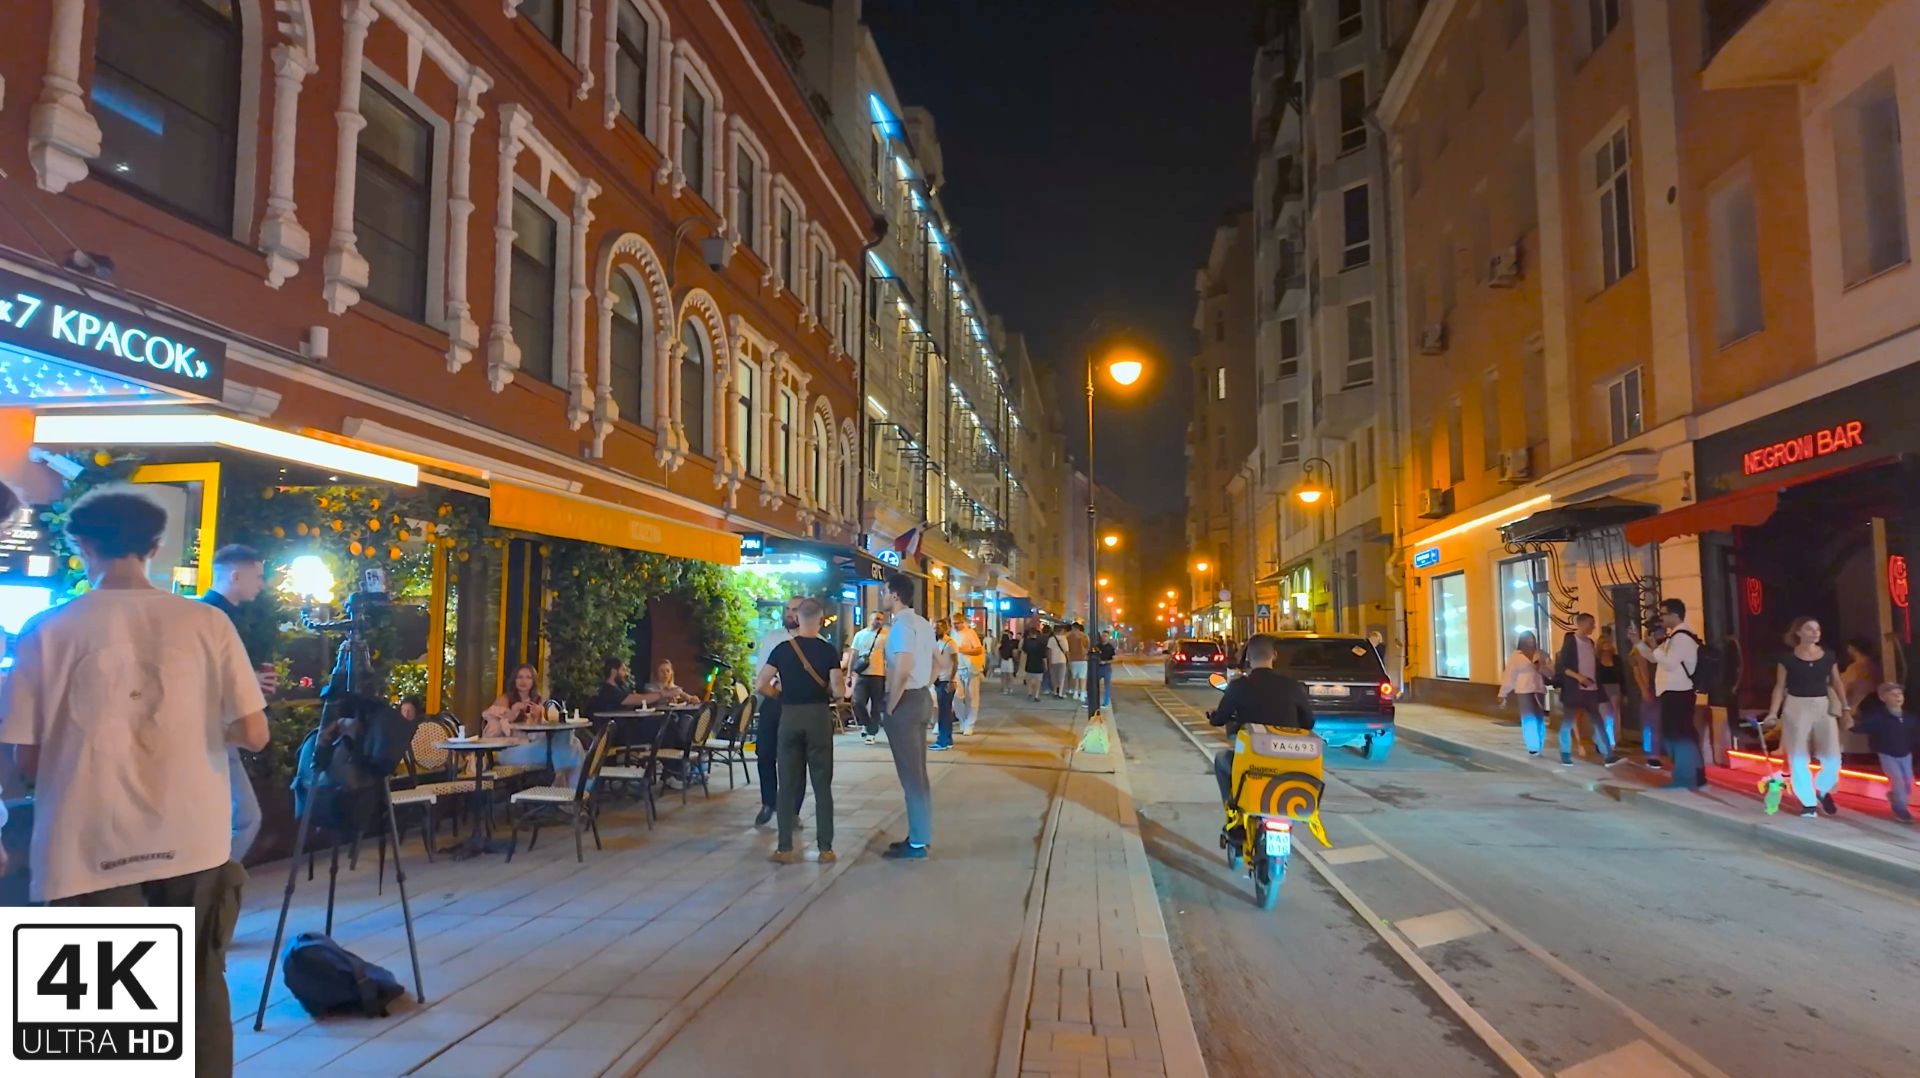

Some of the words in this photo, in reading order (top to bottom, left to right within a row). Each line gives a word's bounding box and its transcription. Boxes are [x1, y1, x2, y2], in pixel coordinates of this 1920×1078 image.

[52, 305, 209, 379] КРАСОК»
[1744, 434, 1814, 475] NEGRONI
[1817, 420, 1863, 455] BAR
